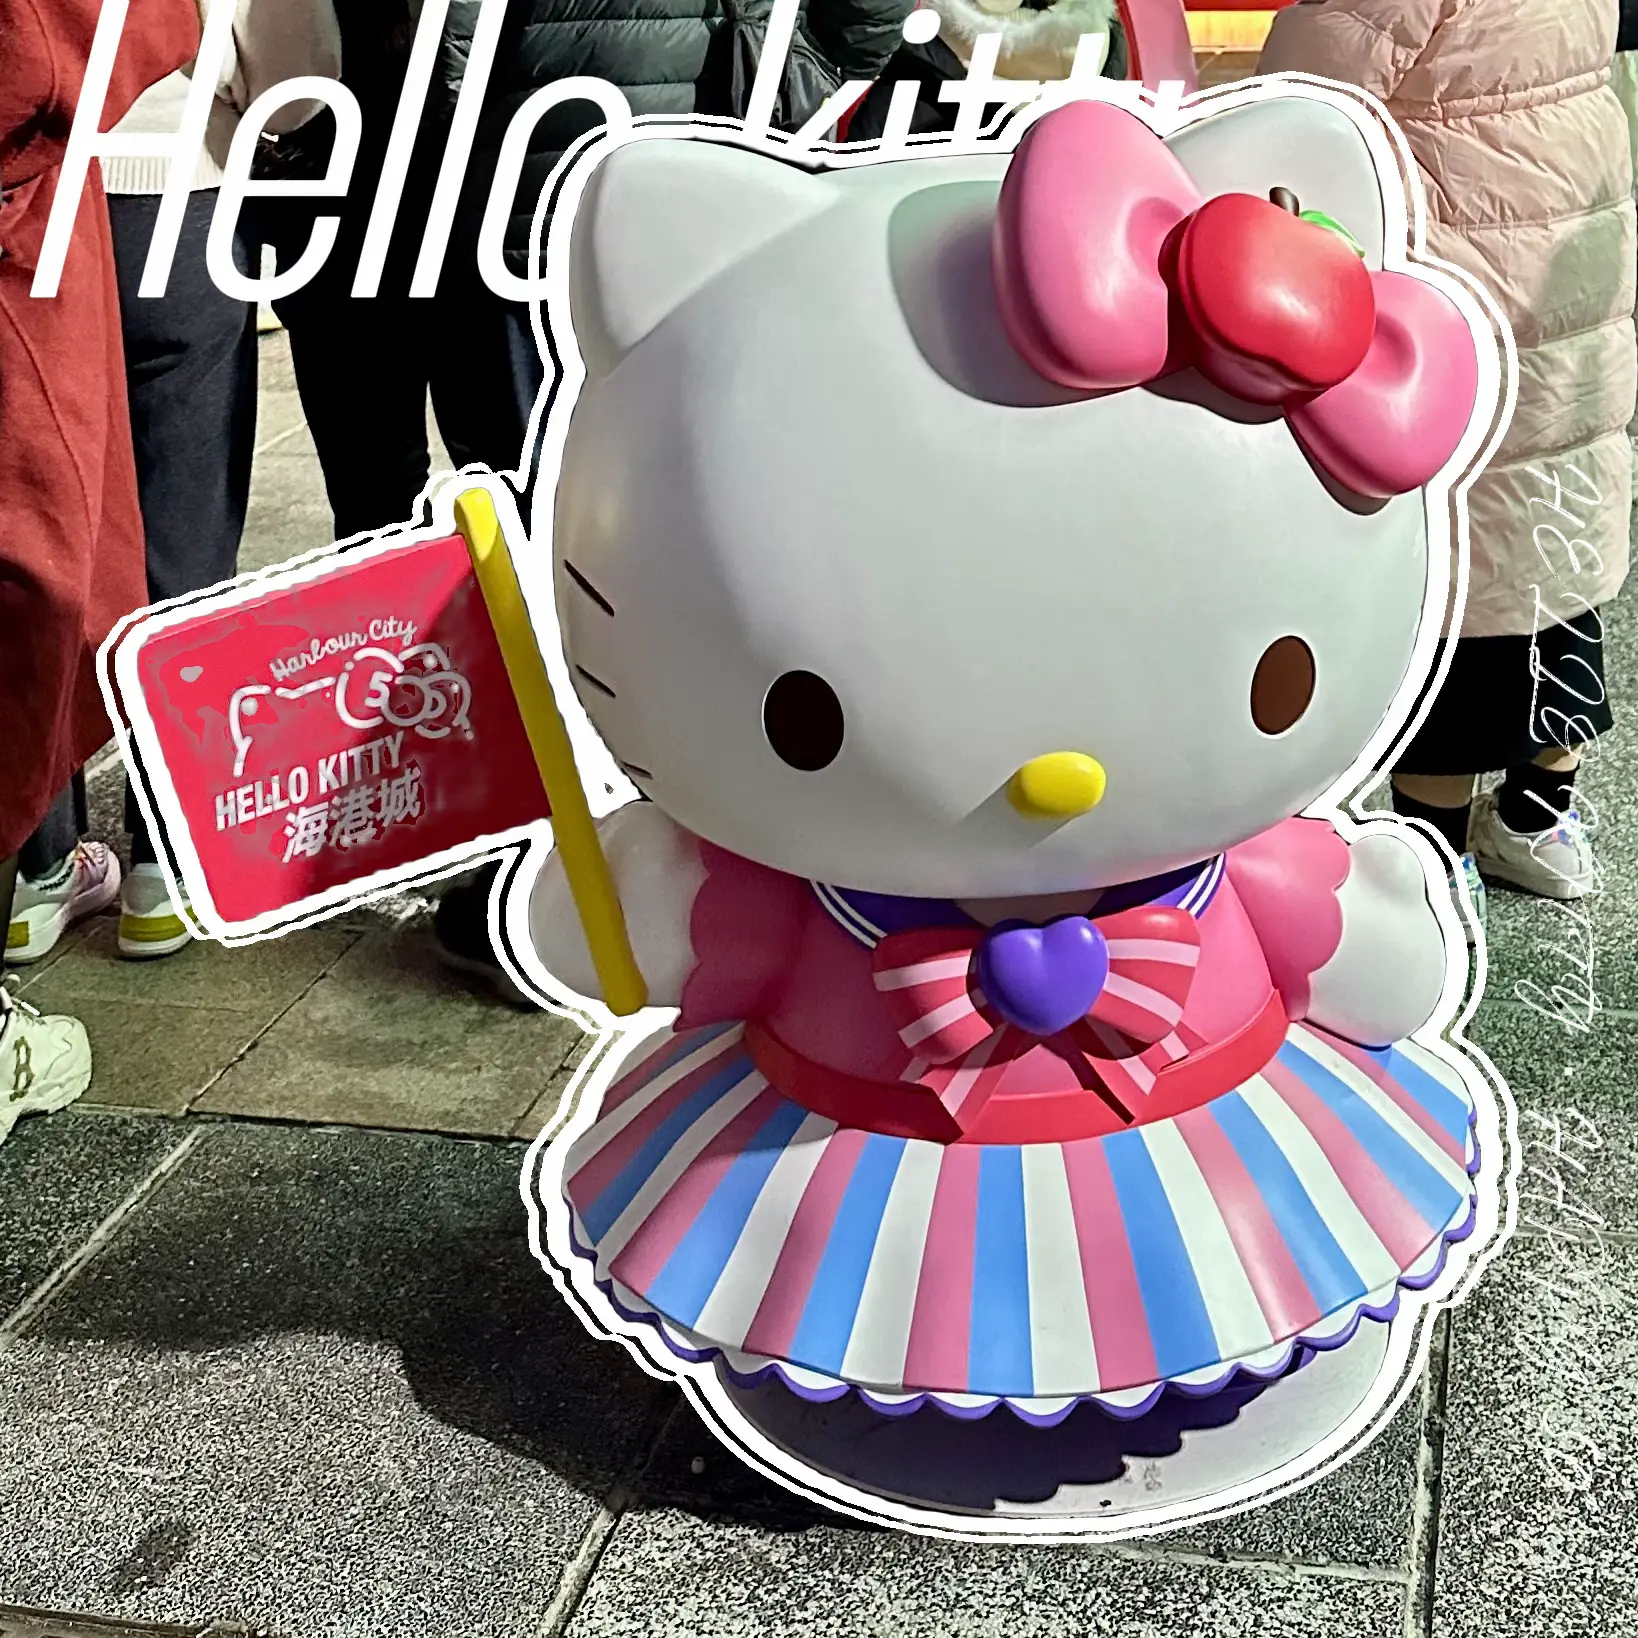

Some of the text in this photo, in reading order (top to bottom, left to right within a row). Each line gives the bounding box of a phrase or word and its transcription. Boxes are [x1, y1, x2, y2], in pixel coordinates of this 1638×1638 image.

[269, 615, 418, 682] Harbour City
[215, 730, 405, 831] HELLO KITTY
[281, 766, 422, 864] 海港城
